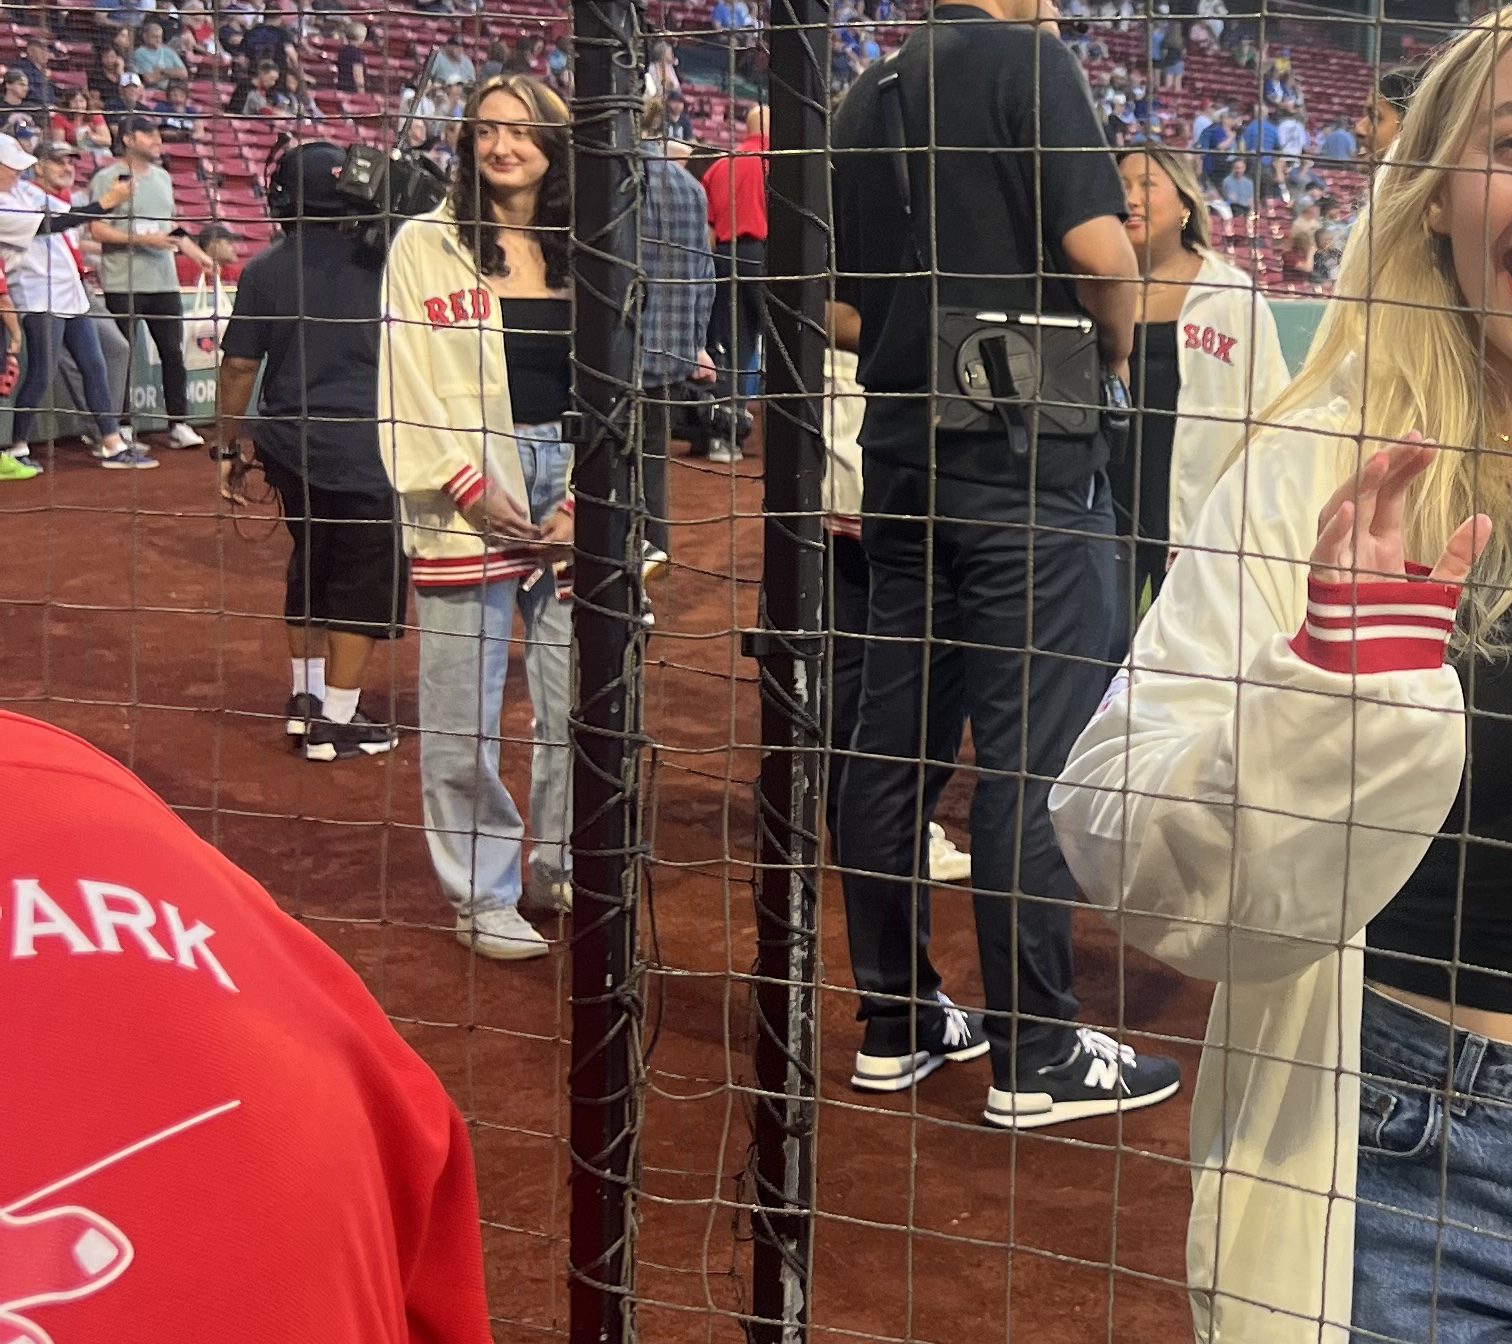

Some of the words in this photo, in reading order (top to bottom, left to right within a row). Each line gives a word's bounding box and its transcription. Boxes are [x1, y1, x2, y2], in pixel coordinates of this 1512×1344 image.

[424, 287, 491, 331] RED
[1184, 323, 1239, 365] SOX
[130, 385, 158, 408] OR
[9, 877, 240, 994] ARK
